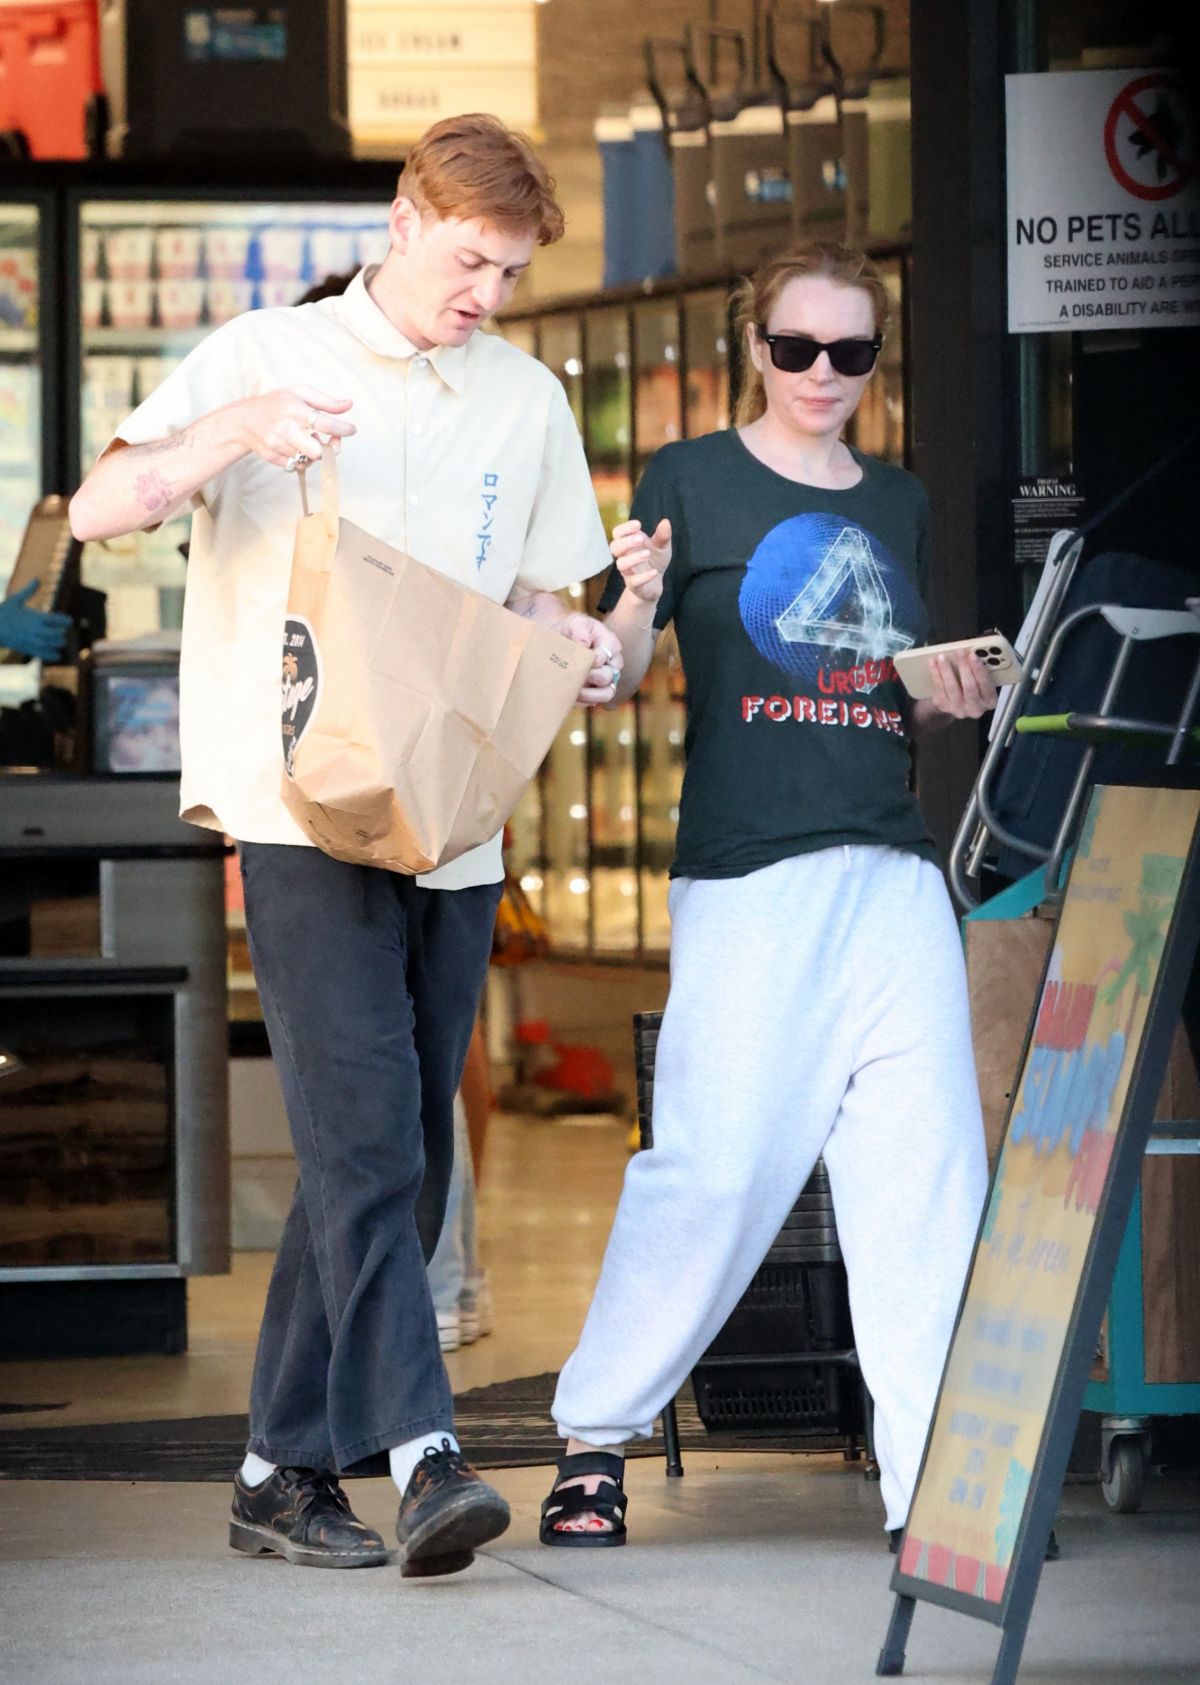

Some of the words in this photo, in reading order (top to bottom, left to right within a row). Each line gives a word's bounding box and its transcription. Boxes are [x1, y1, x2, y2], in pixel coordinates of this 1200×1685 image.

[1016, 217, 1057, 246] NO
[1068, 213, 1142, 243] PETS
[1043, 252, 1103, 268] SERVICE
[1106, 250, 1168, 267] ANIMALS
[1046, 277, 1105, 293] TRAINED
[1110, 276, 1128, 291] TO
[1131, 276, 1154, 290] AID
[1159, 275, 1168, 289] A
[1059, 304, 1069, 318] A
[1072, 302, 1147, 318] DISABILITY
[1150, 300, 1179, 315] ARE
[1019, 484, 1076, 497] WARNING
